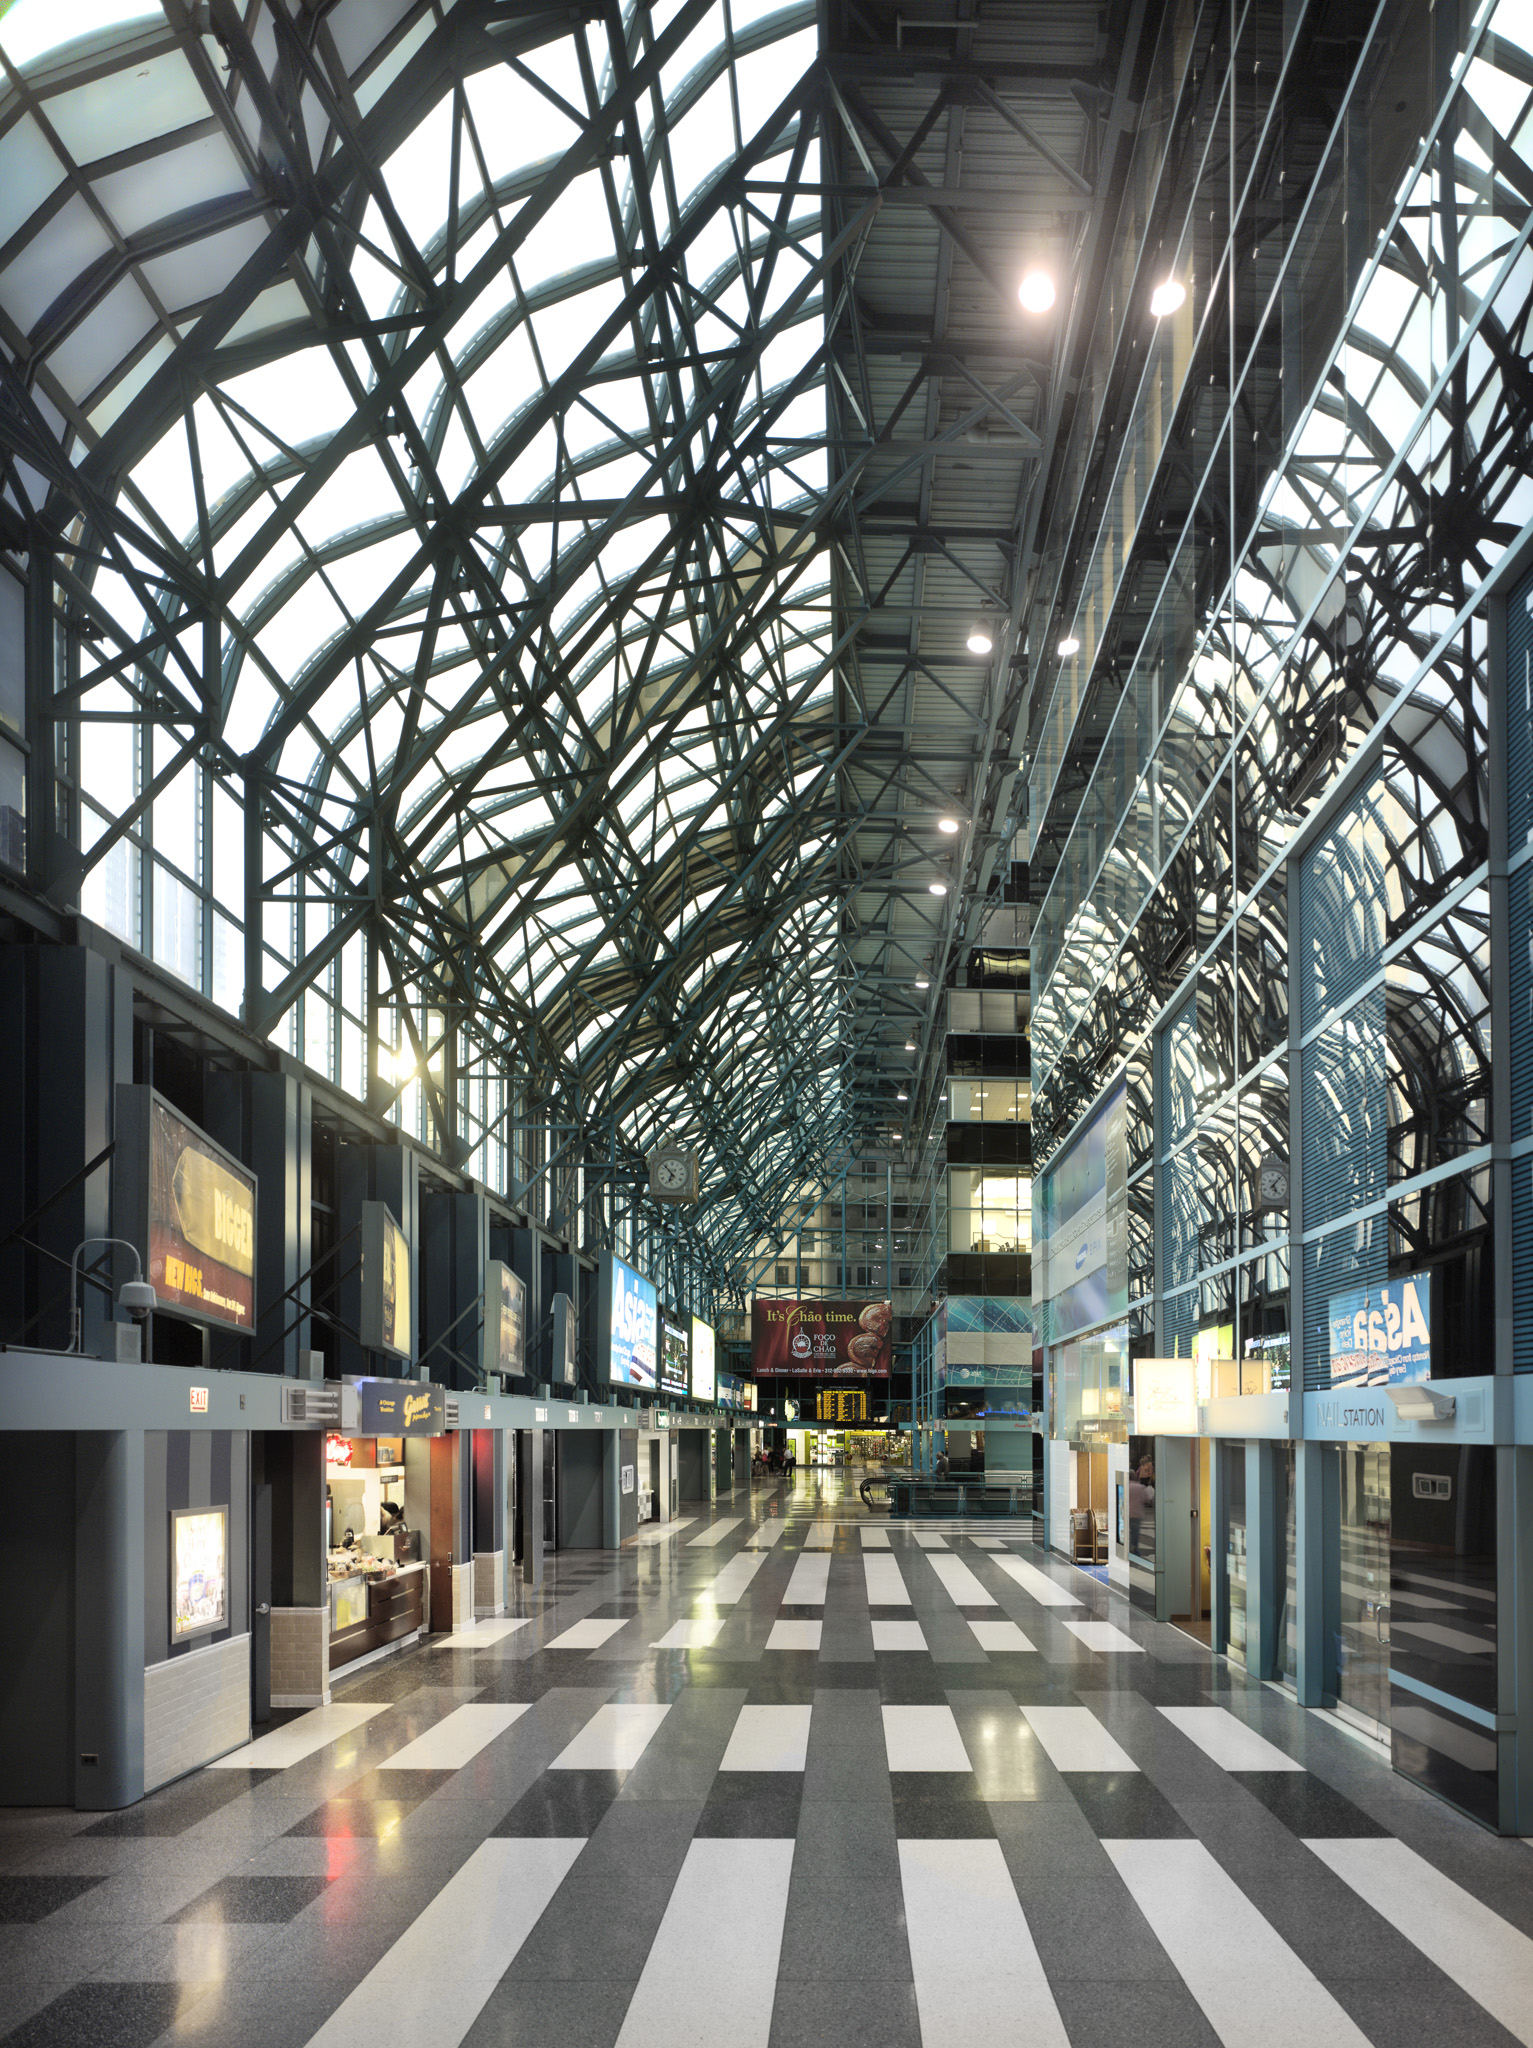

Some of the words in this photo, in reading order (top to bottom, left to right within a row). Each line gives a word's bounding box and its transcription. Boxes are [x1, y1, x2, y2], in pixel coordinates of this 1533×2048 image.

[165, 1255, 185, 1290] NEW
[612, 1267, 646, 1344] Asia
[766, 1310, 784, 1322] It's
[786, 1306, 822, 1326] Chão
[826, 1311, 856, 1322] time.
[191, 1390, 206, 1405] EXIT
[1317, 1402, 1343, 1427] NAIL
[1344, 1408, 1384, 1426] STATION
